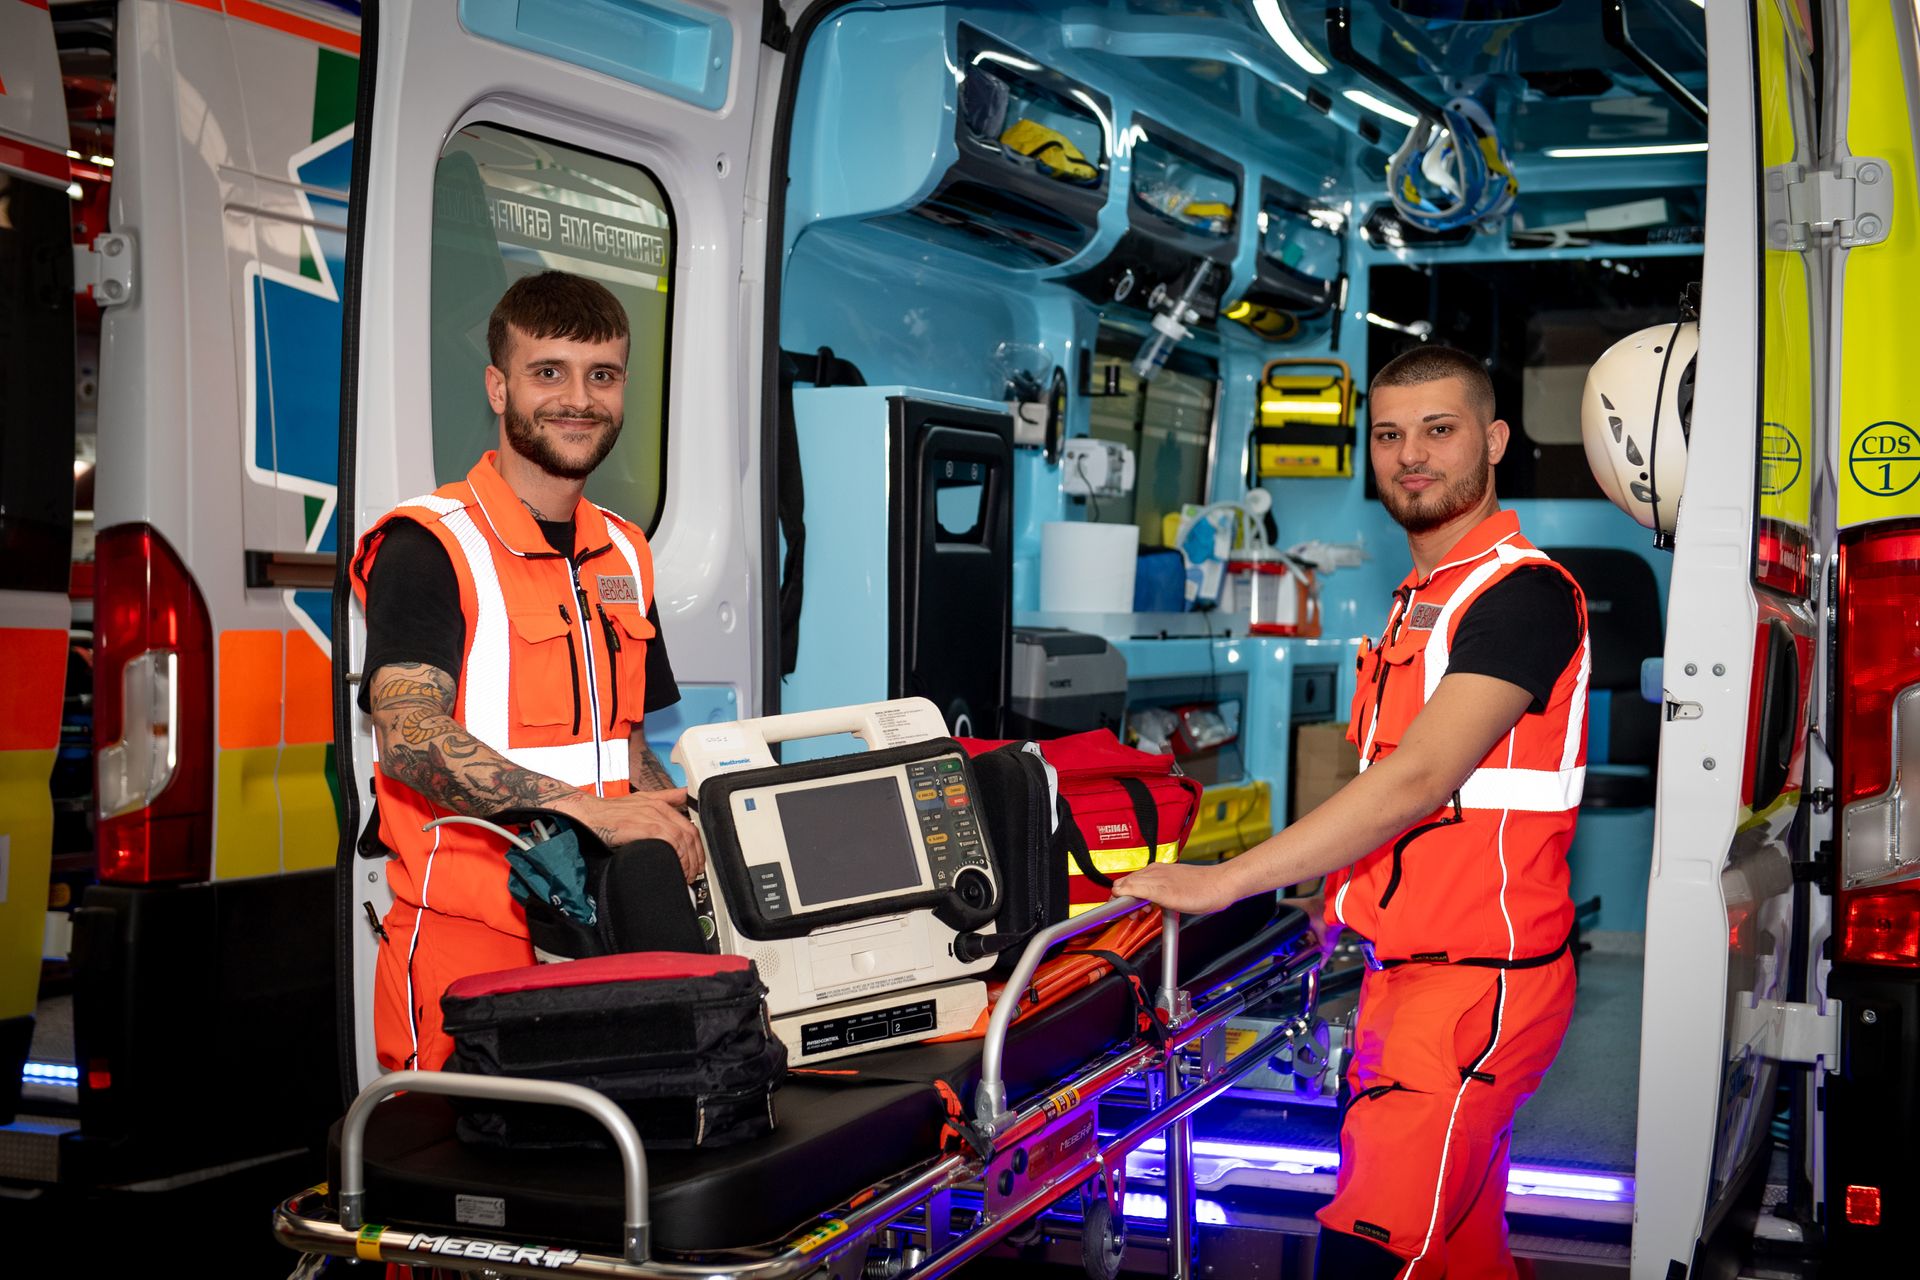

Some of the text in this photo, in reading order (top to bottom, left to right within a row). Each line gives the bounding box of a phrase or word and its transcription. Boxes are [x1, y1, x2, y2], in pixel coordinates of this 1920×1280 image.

[1861, 435, 1911, 455] CDS
[1878, 462, 1894, 490] 1
[600, 578, 629, 589] ROMA
[600, 589, 638, 600] MEDICAL
[895, 1023, 901, 1032] 2
[850, 1032, 855, 1041] 1
[408, 1233, 546, 1266] MEBER
